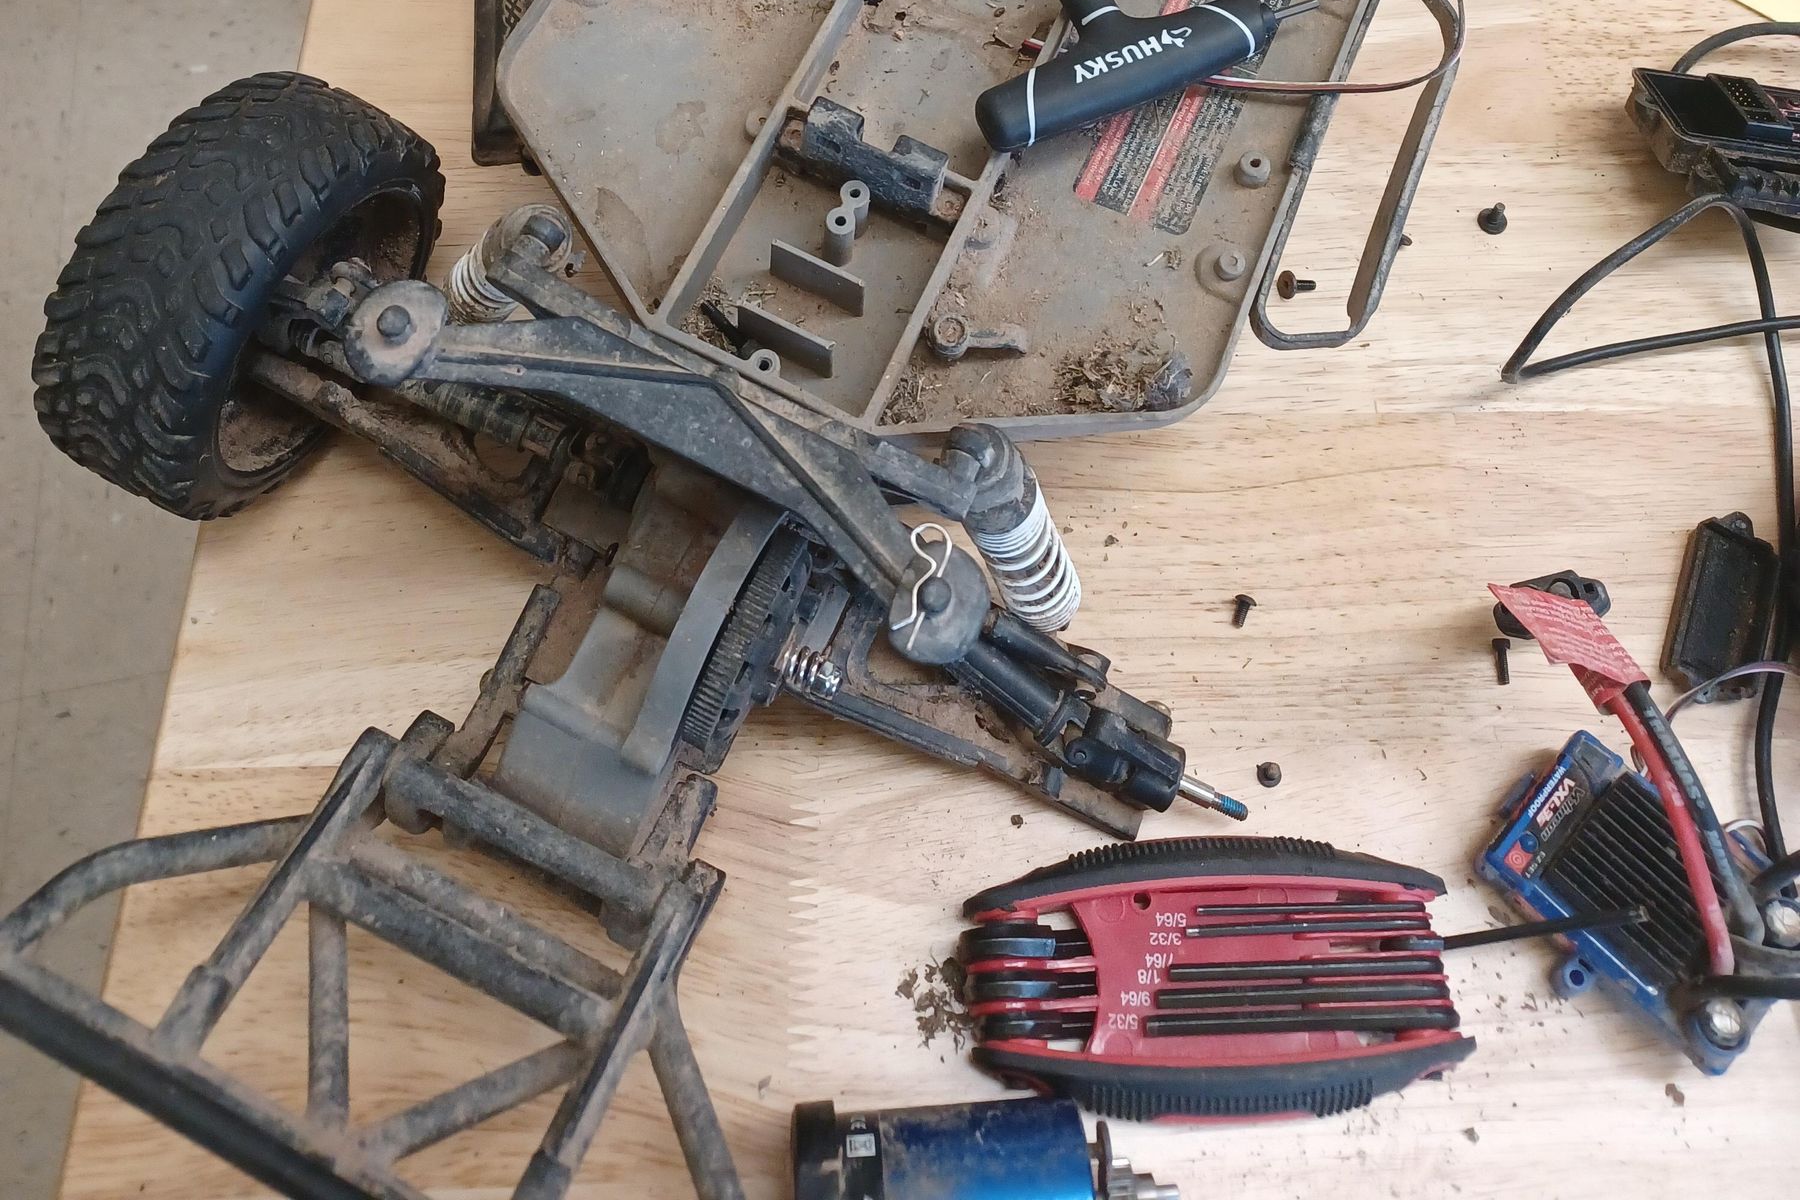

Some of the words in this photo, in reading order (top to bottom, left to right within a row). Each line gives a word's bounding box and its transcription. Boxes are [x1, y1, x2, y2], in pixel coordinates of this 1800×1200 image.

[1073, 36, 1163, 83] HUSKY
[1523, 764, 1567, 818] WATERPROOF
[1154, 910, 1186, 928] 5/64
[1148, 930, 1181, 945] 3/32
[1136, 968, 1160, 985] 1/8
[1120, 989, 1150, 1006] 9/64
[1107, 1011, 1138, 1030] 5/32
